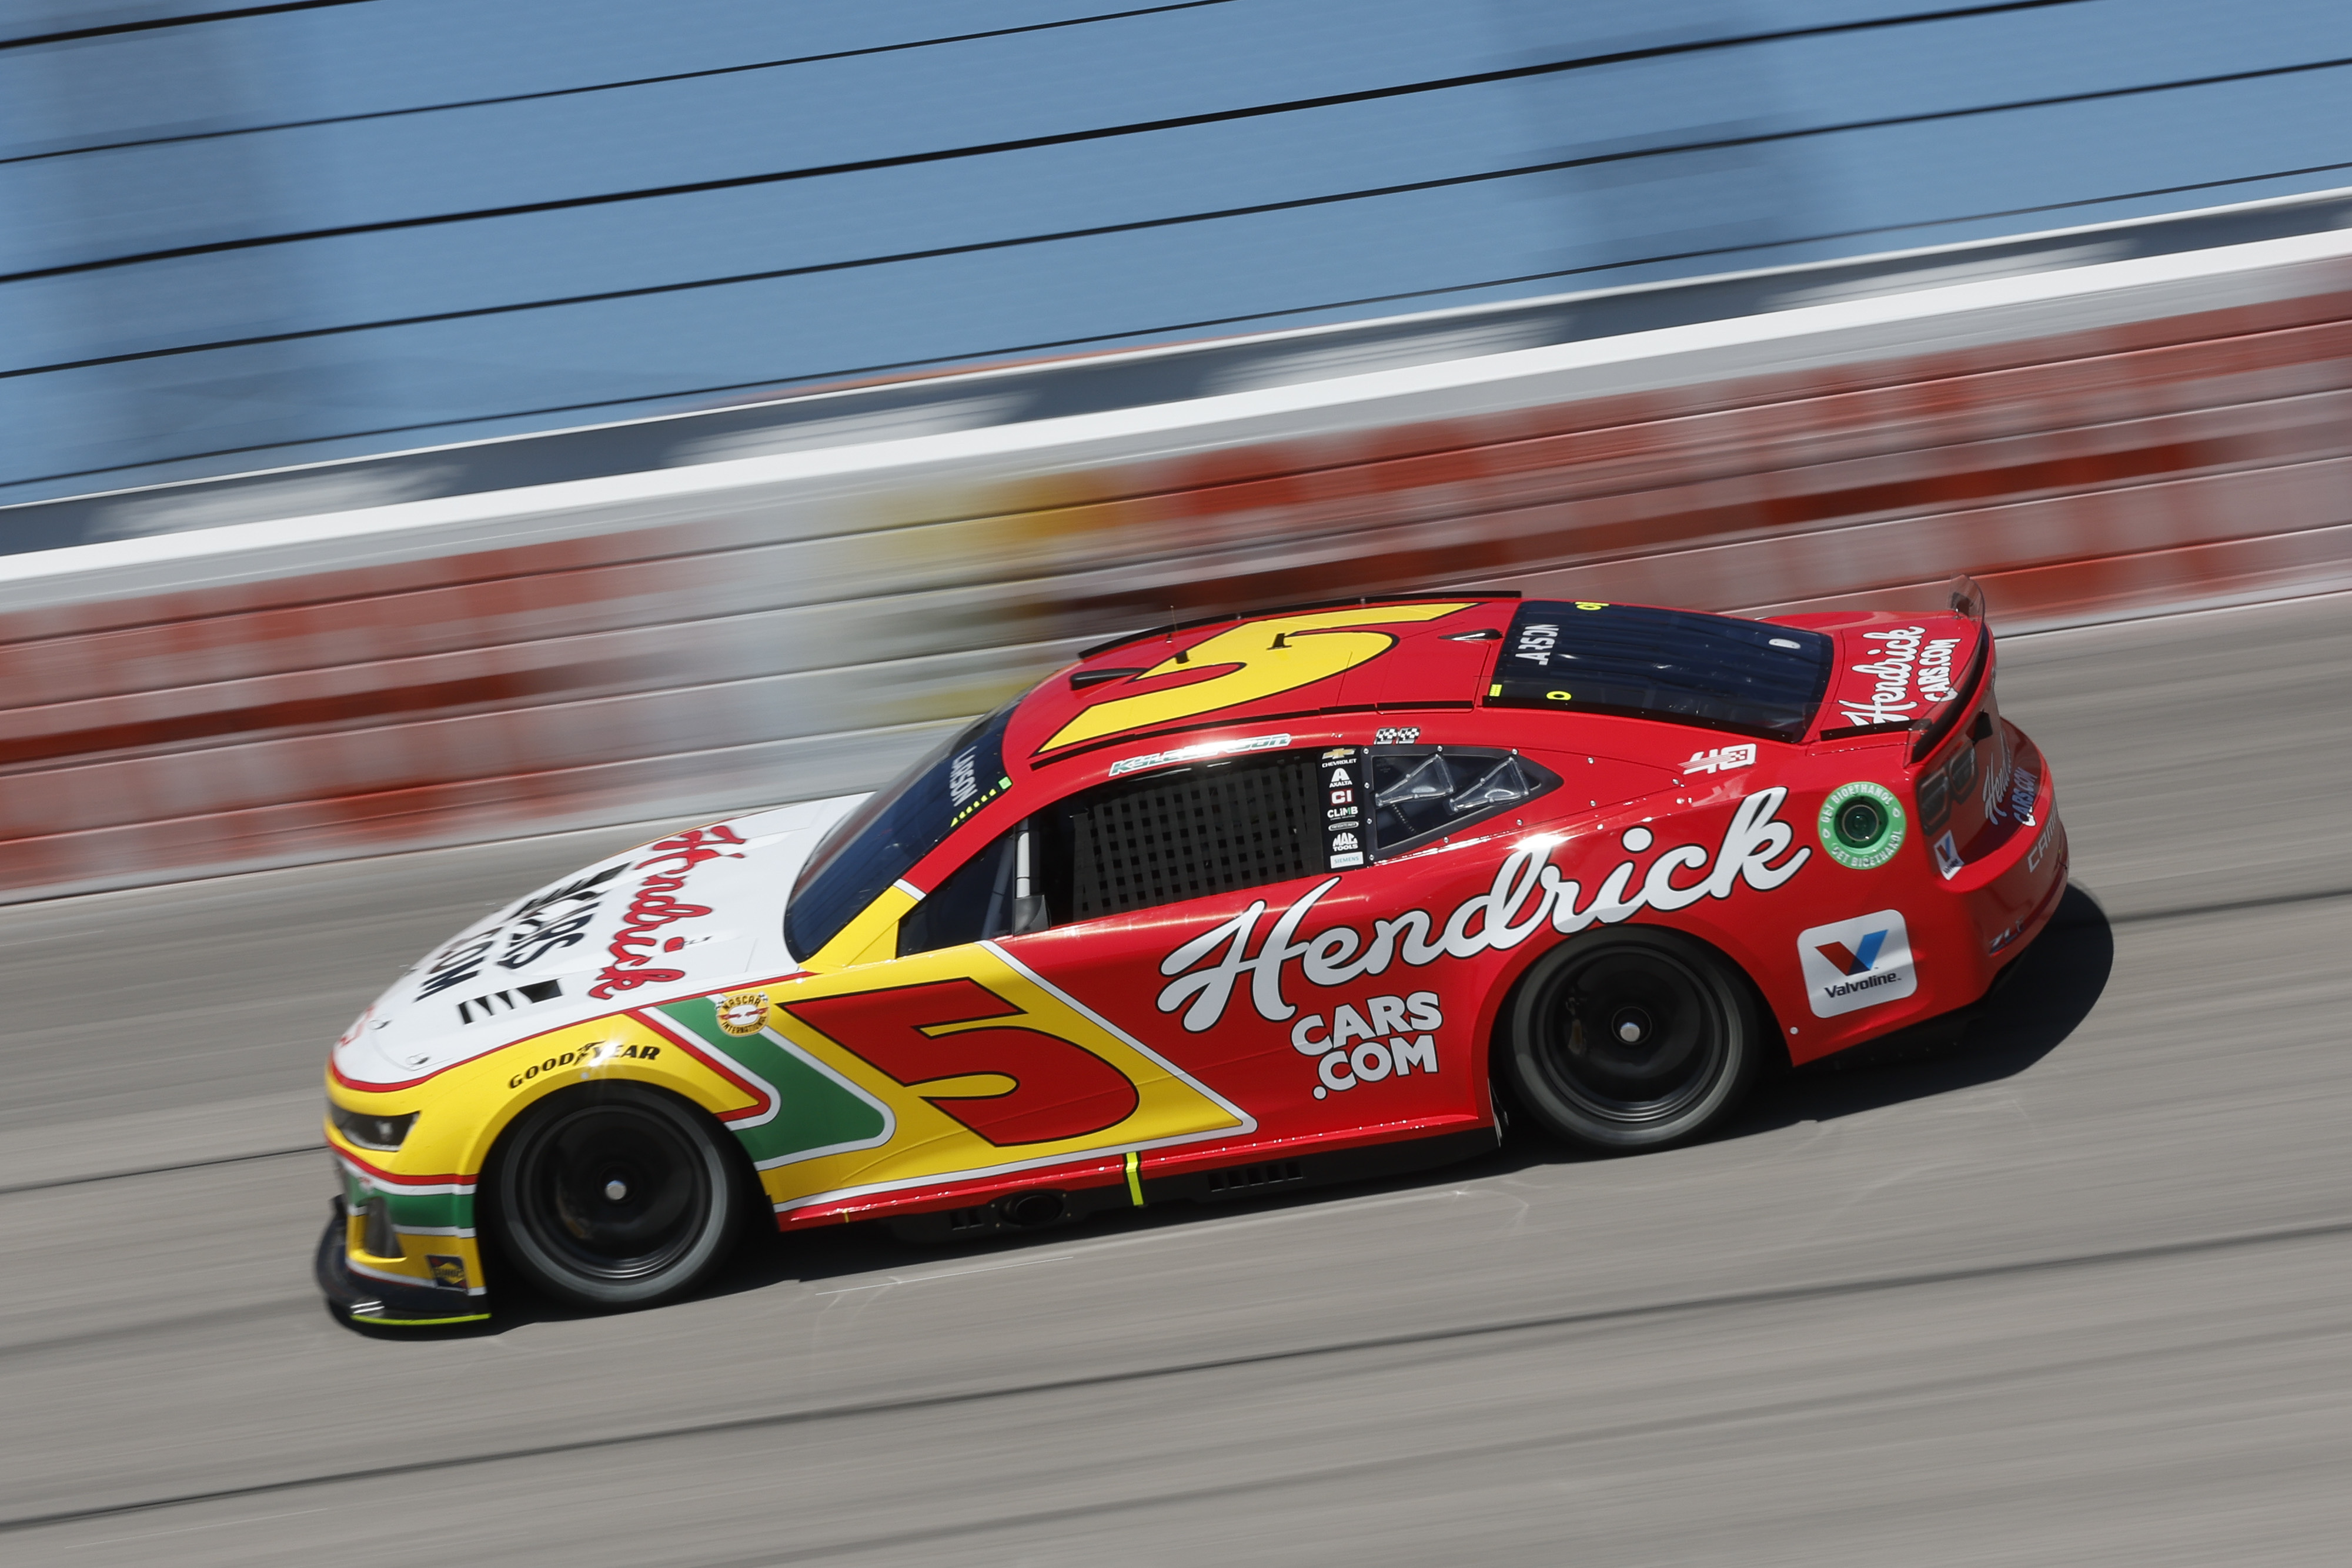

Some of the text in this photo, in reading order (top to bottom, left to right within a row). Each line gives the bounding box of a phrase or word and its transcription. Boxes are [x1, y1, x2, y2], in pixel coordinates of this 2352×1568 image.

[1030, 602, 1481, 758] 5
[1838, 626, 1926, 726] Hendrick
[1917, 638, 1962, 702] CARS.COM
[949, 745, 978, 801] LARSON
[1321, 758, 1357, 768] CHEVROLET
[1329, 780, 1353, 788] AXALTA
[1331, 790, 1352, 804] CI
[1820, 784, 1894, 823] GET BIOETHANOL
[1332, 832, 1358, 847] MAC
[1332, 844, 1359, 852] TOOLS
[1831, 830, 1903, 868] GET BIOETHANOL
[588, 825, 746, 999] Hendrick
[1156, 785, 1812, 1034] Hendrick
[722, 995, 761, 1012] NASCAR
[1823, 972, 1897, 998] Valvoline
[1289, 990, 1444, 1057] CARS
[509, 1044, 660, 1089] GOODYEAR
[779, 976, 1140, 1147] 5
[1312, 1034, 1439, 1101] .COM
